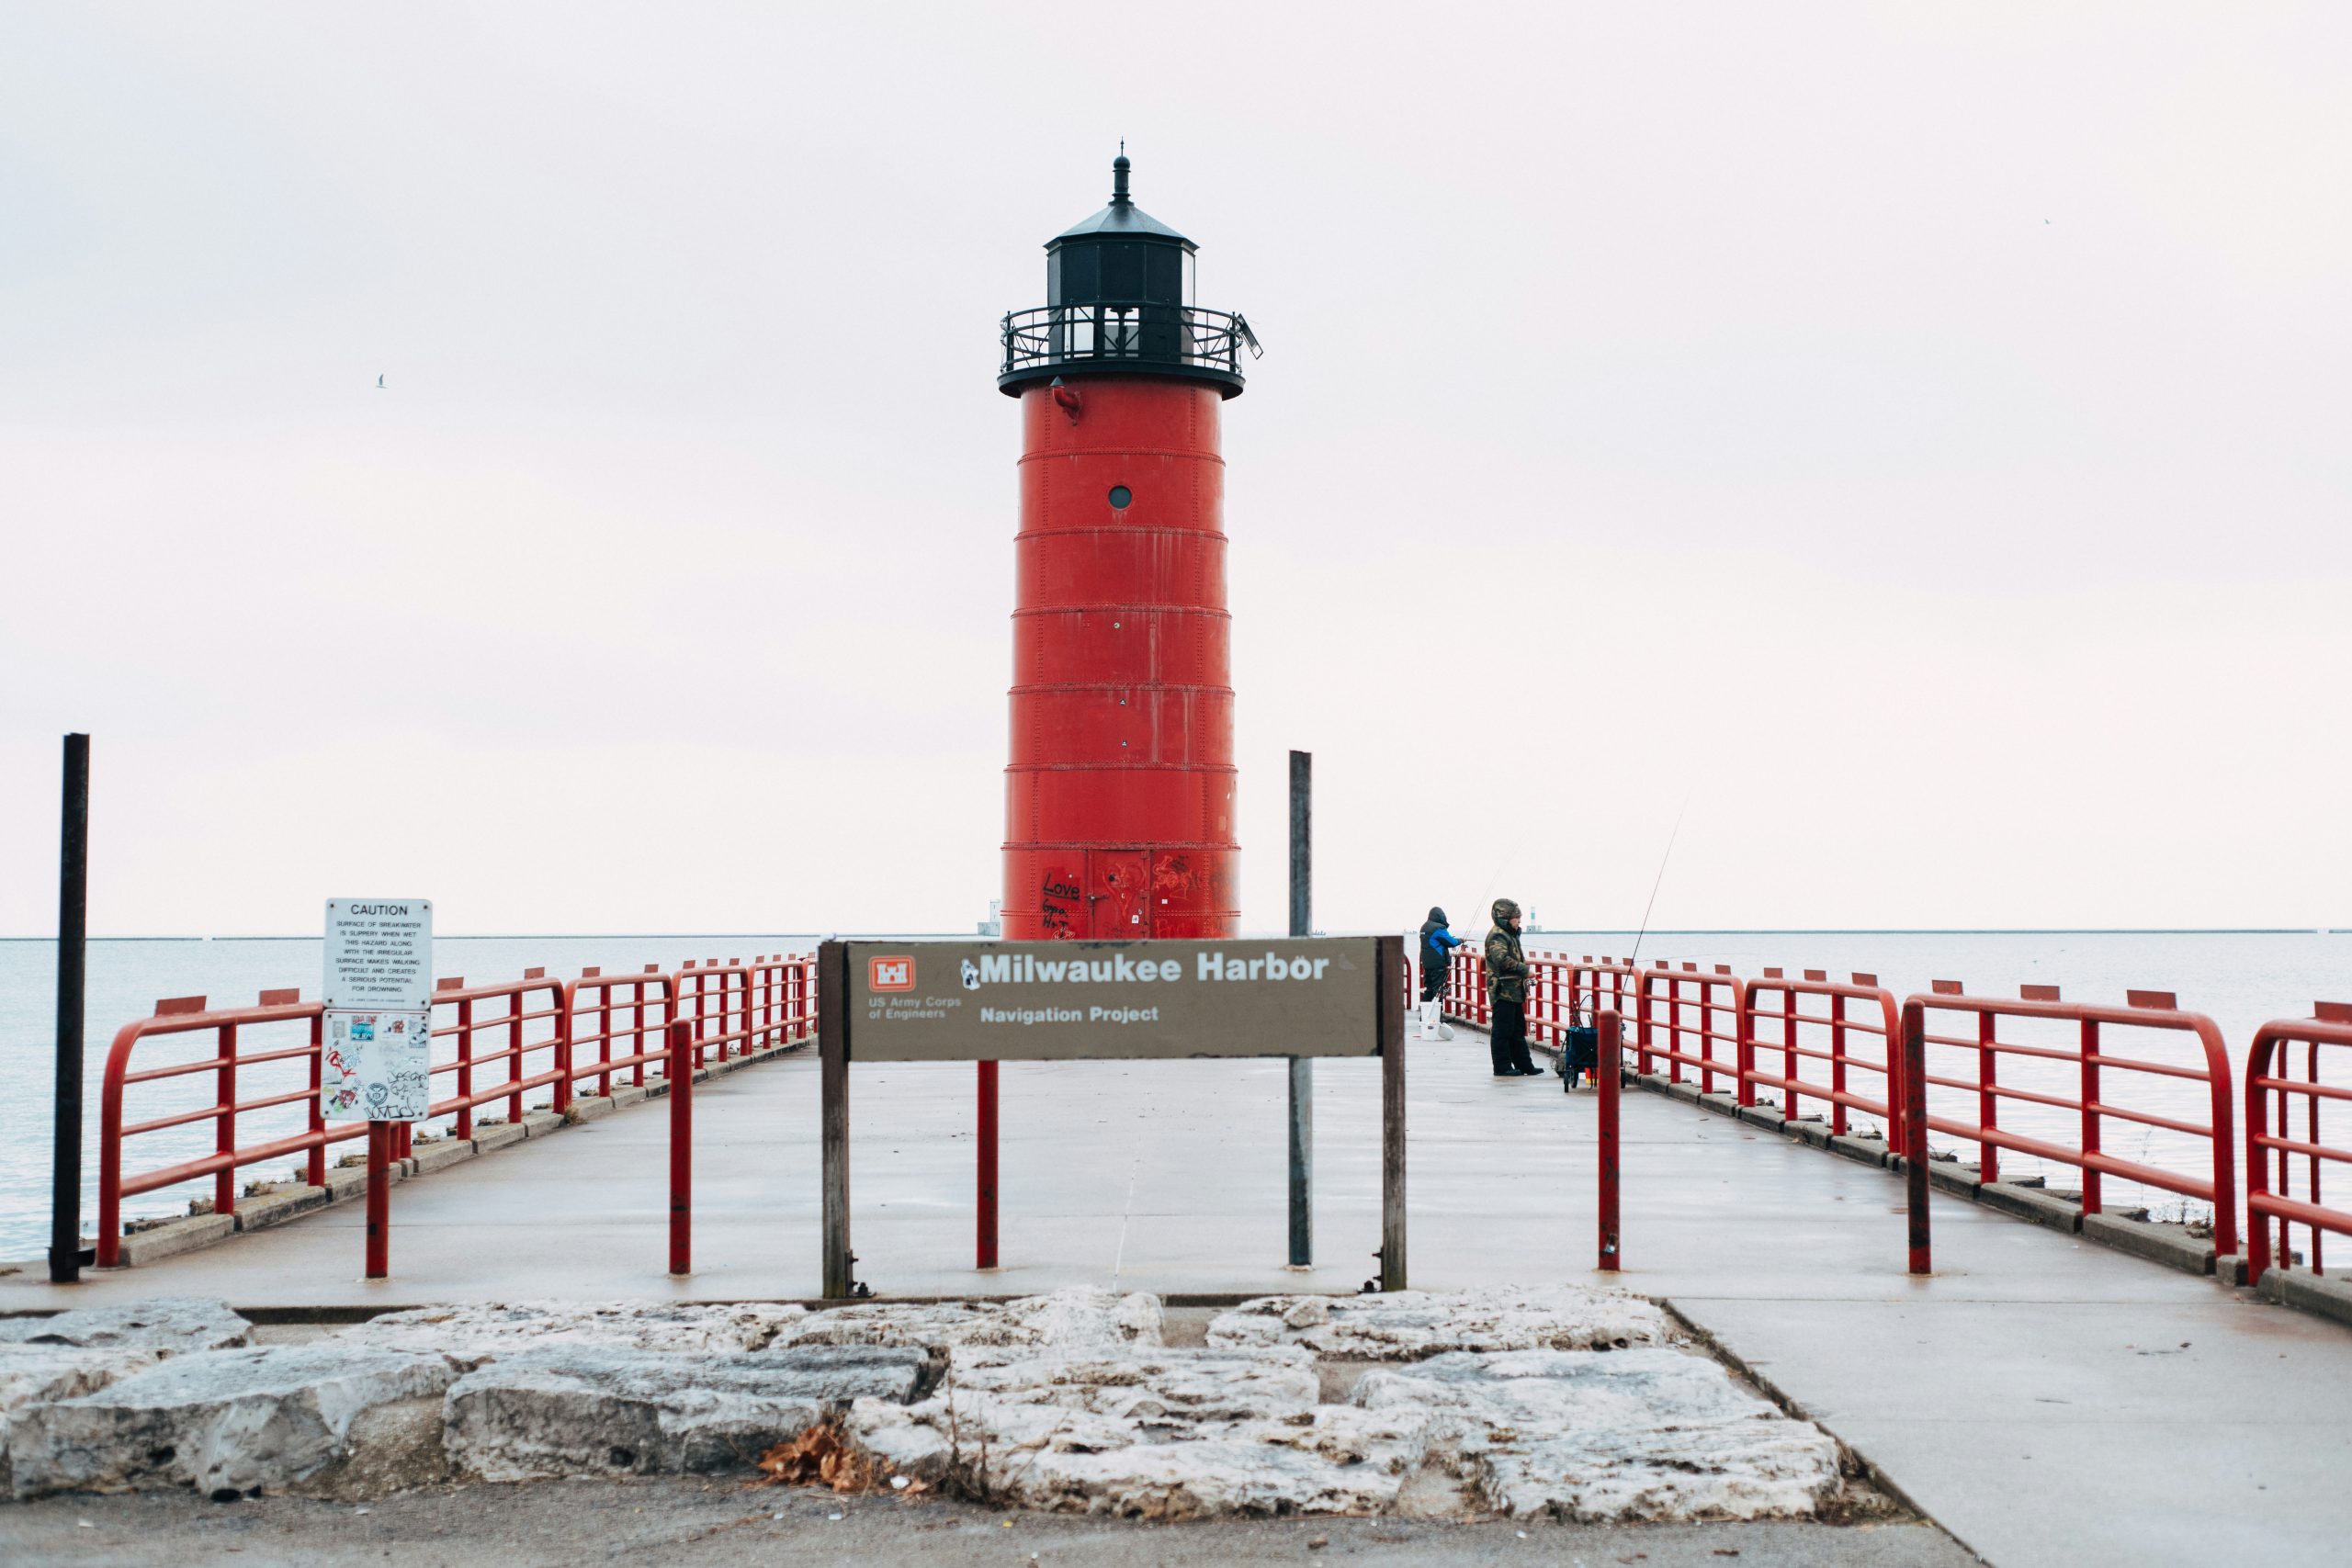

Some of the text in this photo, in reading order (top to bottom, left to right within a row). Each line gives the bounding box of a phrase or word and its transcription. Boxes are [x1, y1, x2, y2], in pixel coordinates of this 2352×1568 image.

[1043, 874, 1080, 899] Love
[351, 905, 408, 916] CAUTION
[980, 953, 1182, 983] Milwaukee
[868, 996, 962, 1009] US Army Corps
[868, 1009, 945, 1021] of Engineers
[980, 1006, 1159, 1025] Navigation Project
